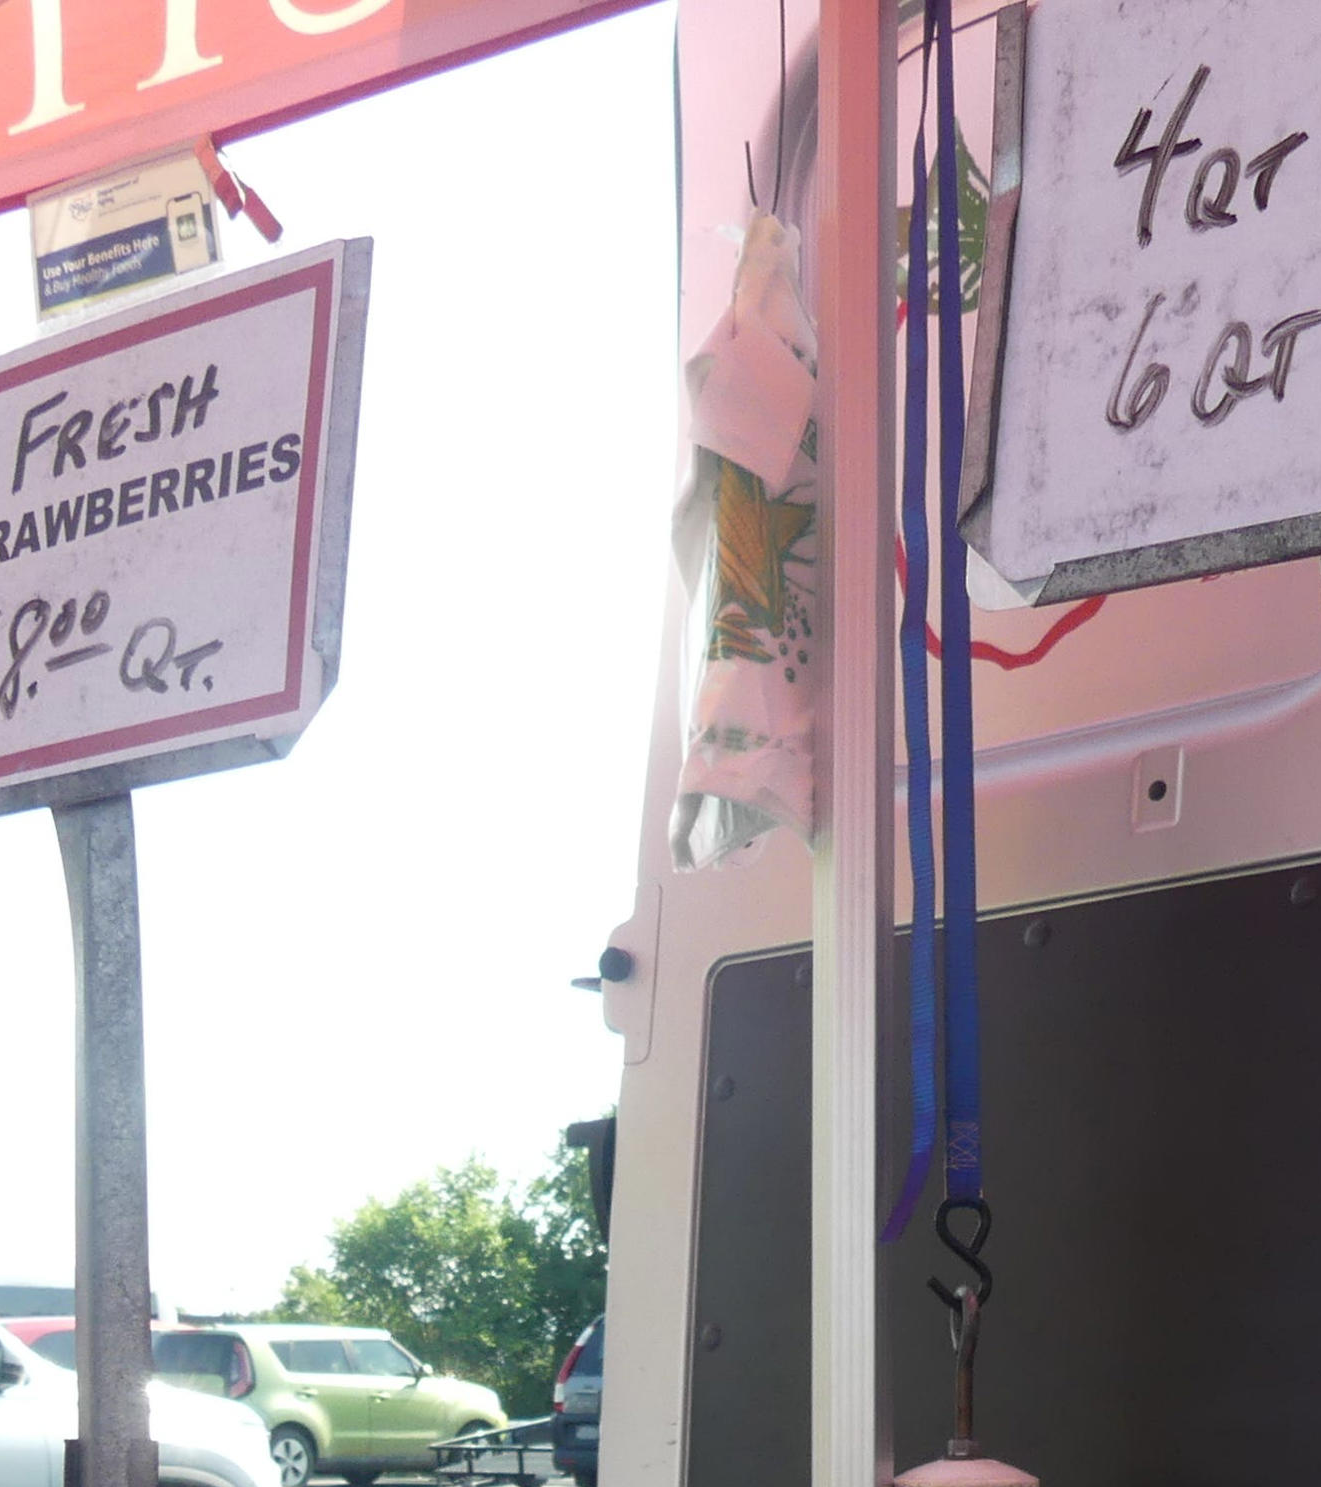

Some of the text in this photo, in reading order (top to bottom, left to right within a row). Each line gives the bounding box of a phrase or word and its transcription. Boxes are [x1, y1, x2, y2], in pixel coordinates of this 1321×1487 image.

[43, 234, 160, 280] Use Your Benefits Here
[11, 363, 220, 495] FRESH
